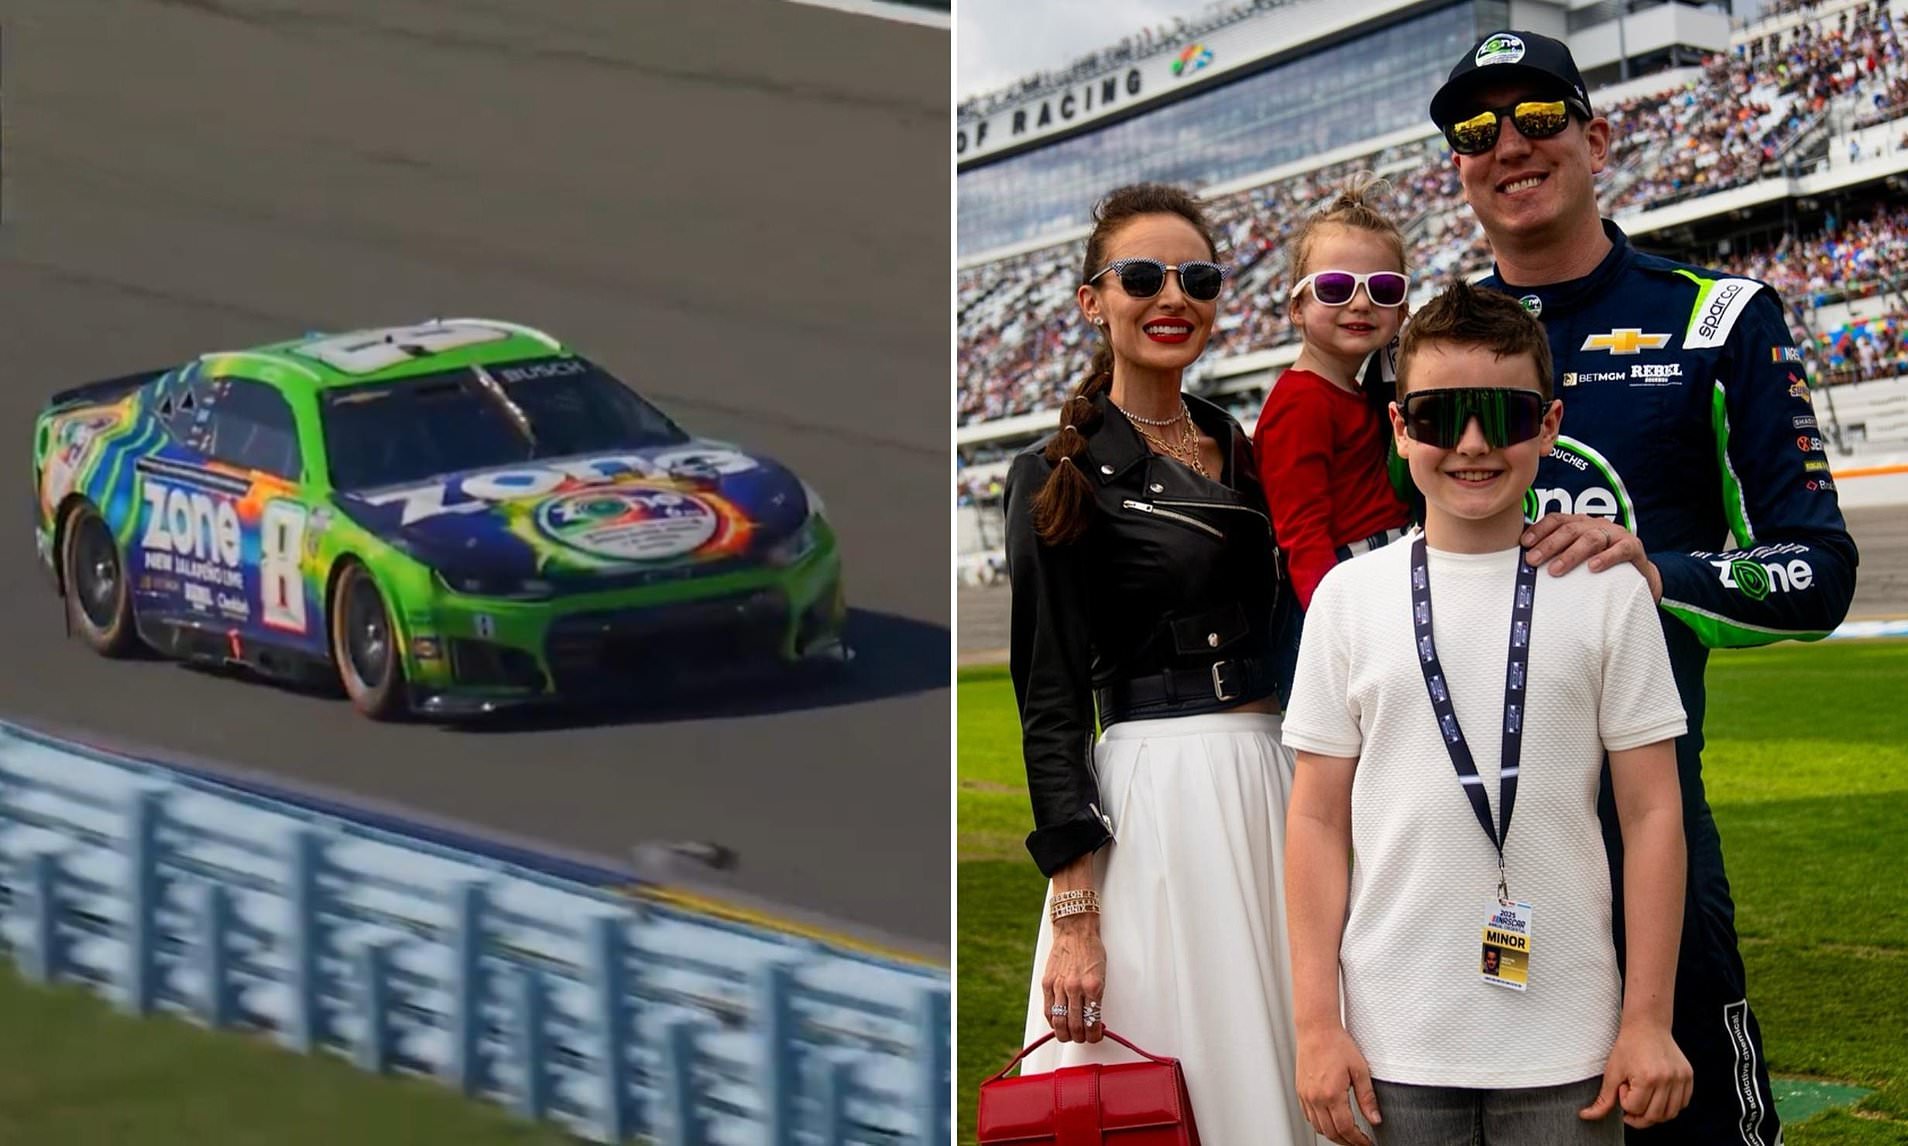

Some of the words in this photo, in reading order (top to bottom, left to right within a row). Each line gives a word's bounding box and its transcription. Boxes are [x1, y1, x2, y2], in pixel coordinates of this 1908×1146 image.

[957, 121, 988, 154] OF
[1012, 68, 1142, 135] RACING
[1699, 284, 1740, 338] sparco
[502, 361, 587, 383] BUSCH
[1579, 372, 1626, 383] BETMGM
[1630, 364, 1683, 378] REBEL
[1548, 447, 1589, 471] OUCHES
[1523, 487, 1618, 525] ne
[142, 482, 242, 568] zone
[261, 500, 307, 634] 8
[1498, 915, 1526, 929] NASCAR
[1500, 910, 1516, 919] 2025
[1486, 930, 1526, 949] MINOR
[1731, 1011, 1750, 1060] chemical.
[1741, 1063, 1757, 1109] addictive
